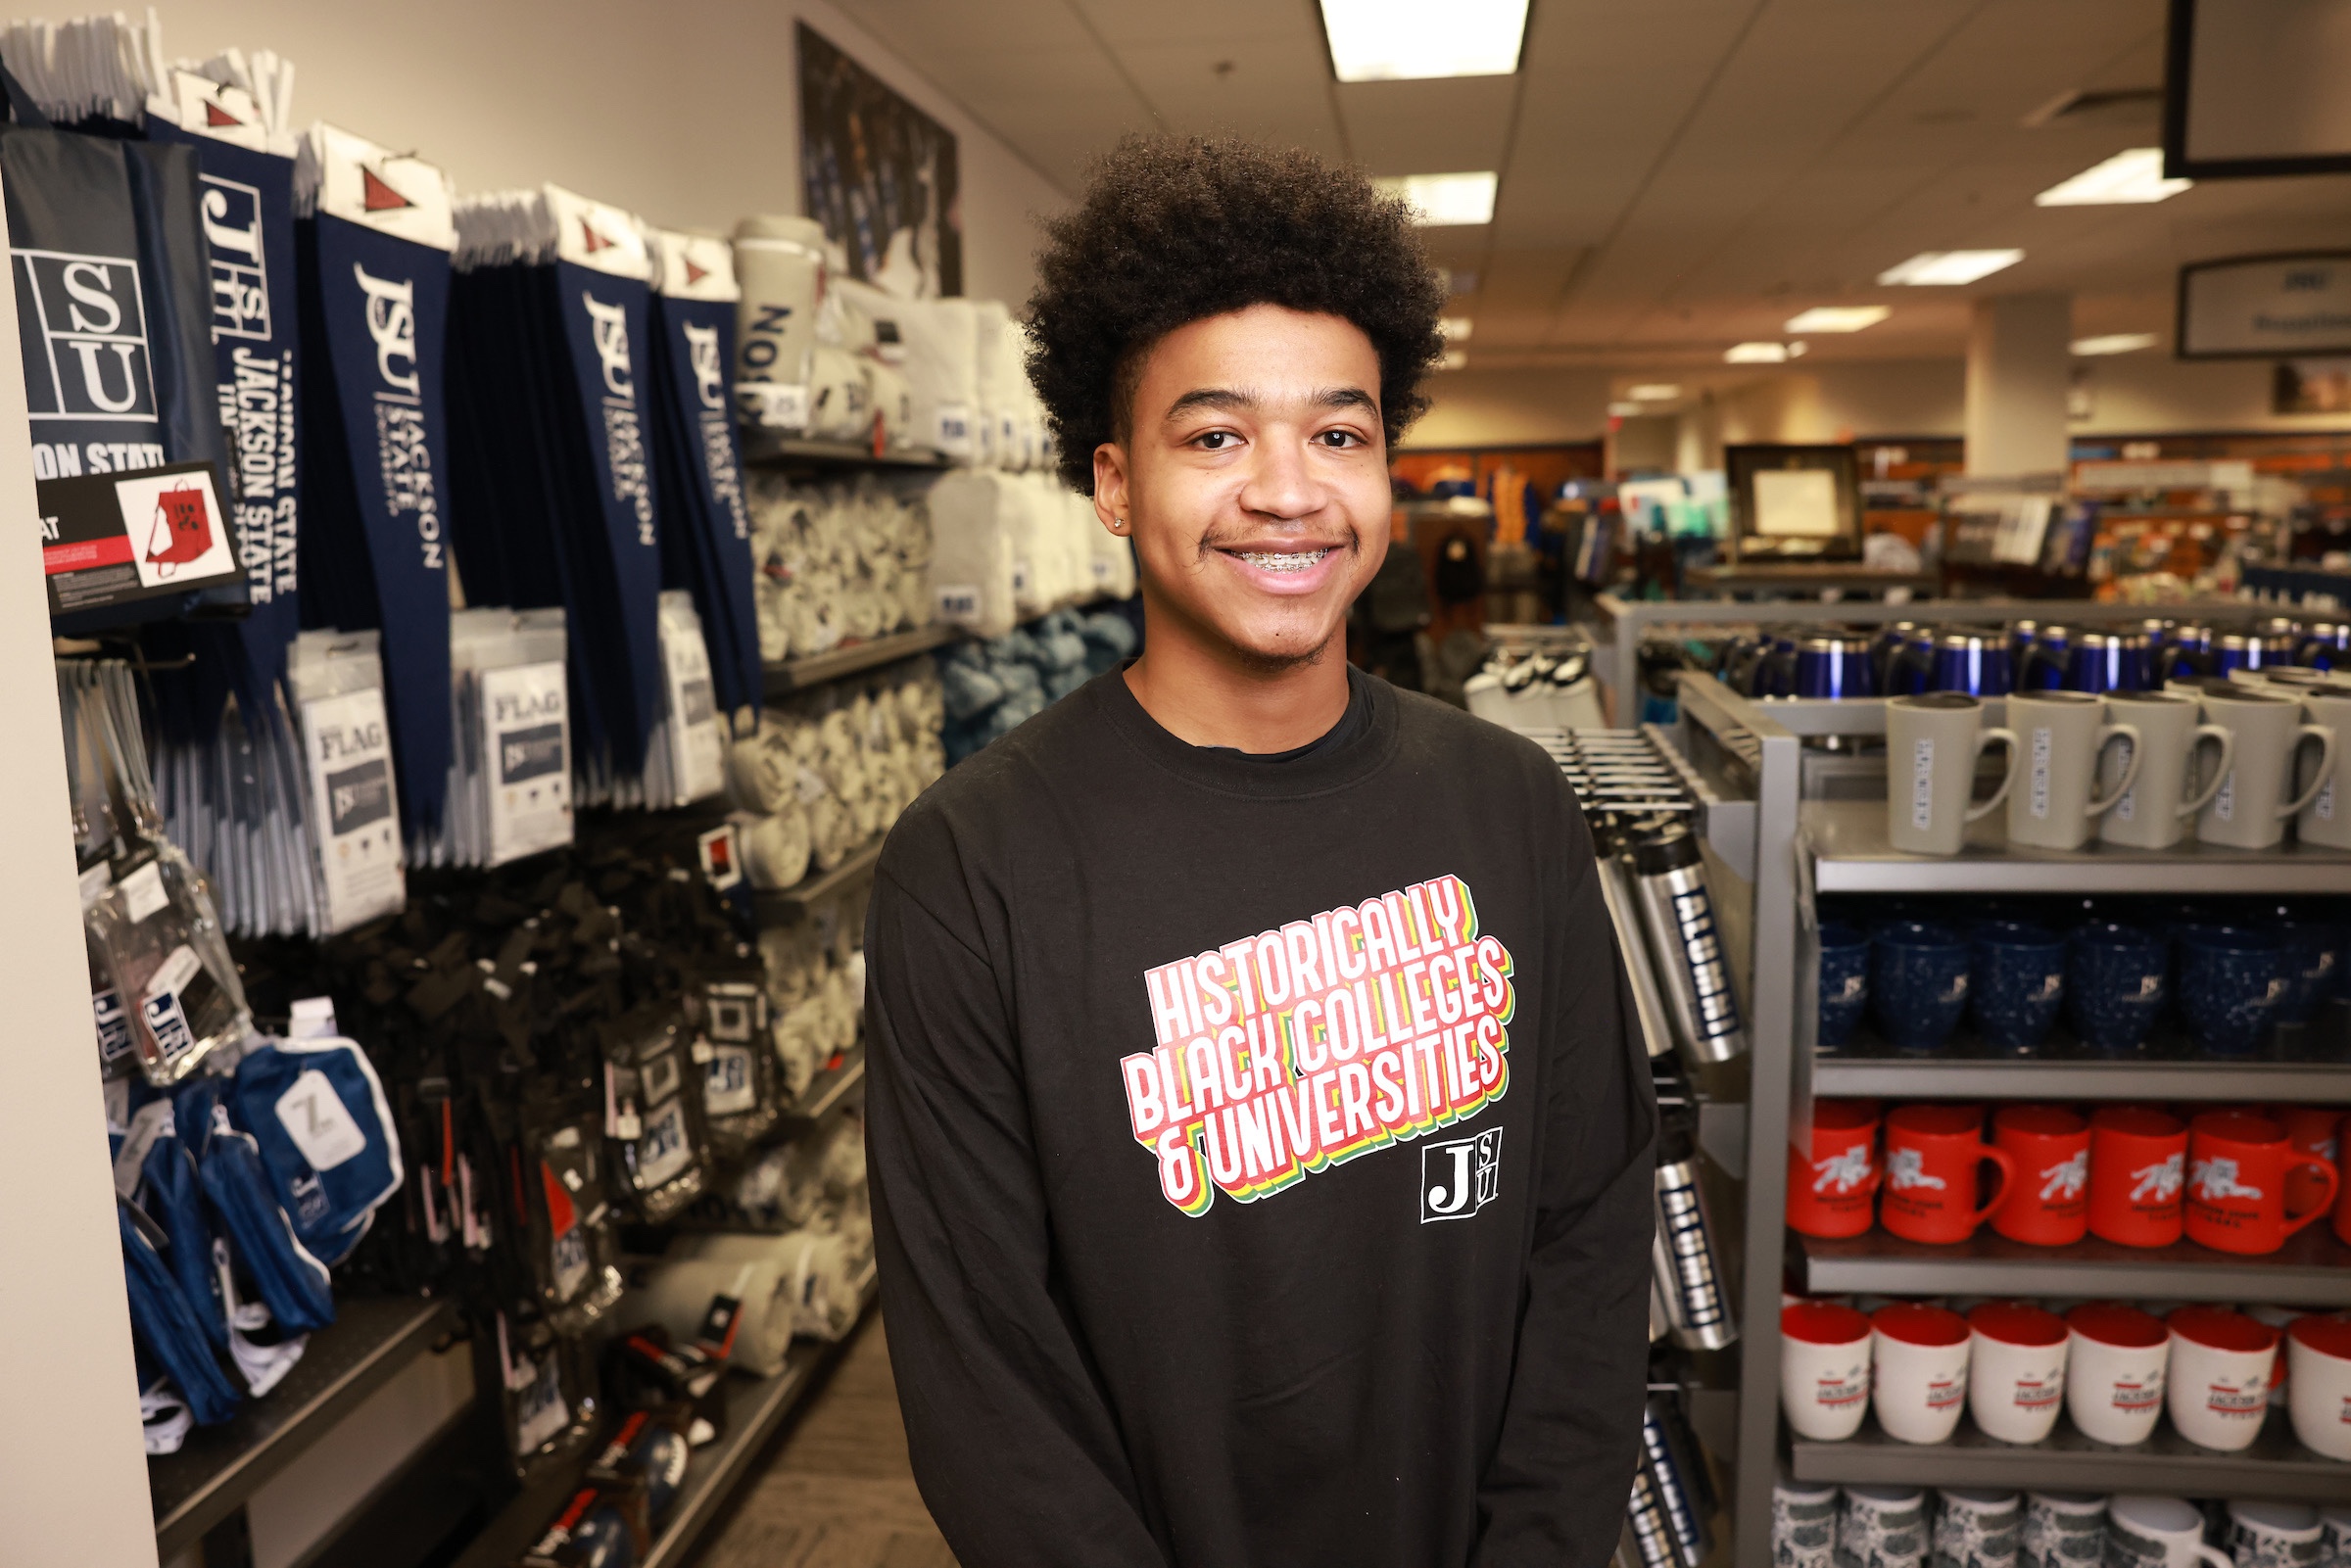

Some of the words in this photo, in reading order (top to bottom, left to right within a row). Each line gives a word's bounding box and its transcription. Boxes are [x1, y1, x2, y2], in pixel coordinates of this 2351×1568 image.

[353, 261, 420, 397] JSU
[232, 347, 278, 499] JACKSON
[403, 409, 444, 569] JACKSON
[245, 505, 273, 604] STATE
[318, 723, 383, 760] FLAG
[497, 690, 559, 722] FLAG
[1144, 875, 1475, 1046] HISTORICALLY
[1122, 1012, 1291, 1139] BLACK
[1290, 936, 1512, 1075] COLLEGES
[1157, 1122, 1212, 1214] &
[1201, 1015, 1507, 1193] UNIVERSITIES
